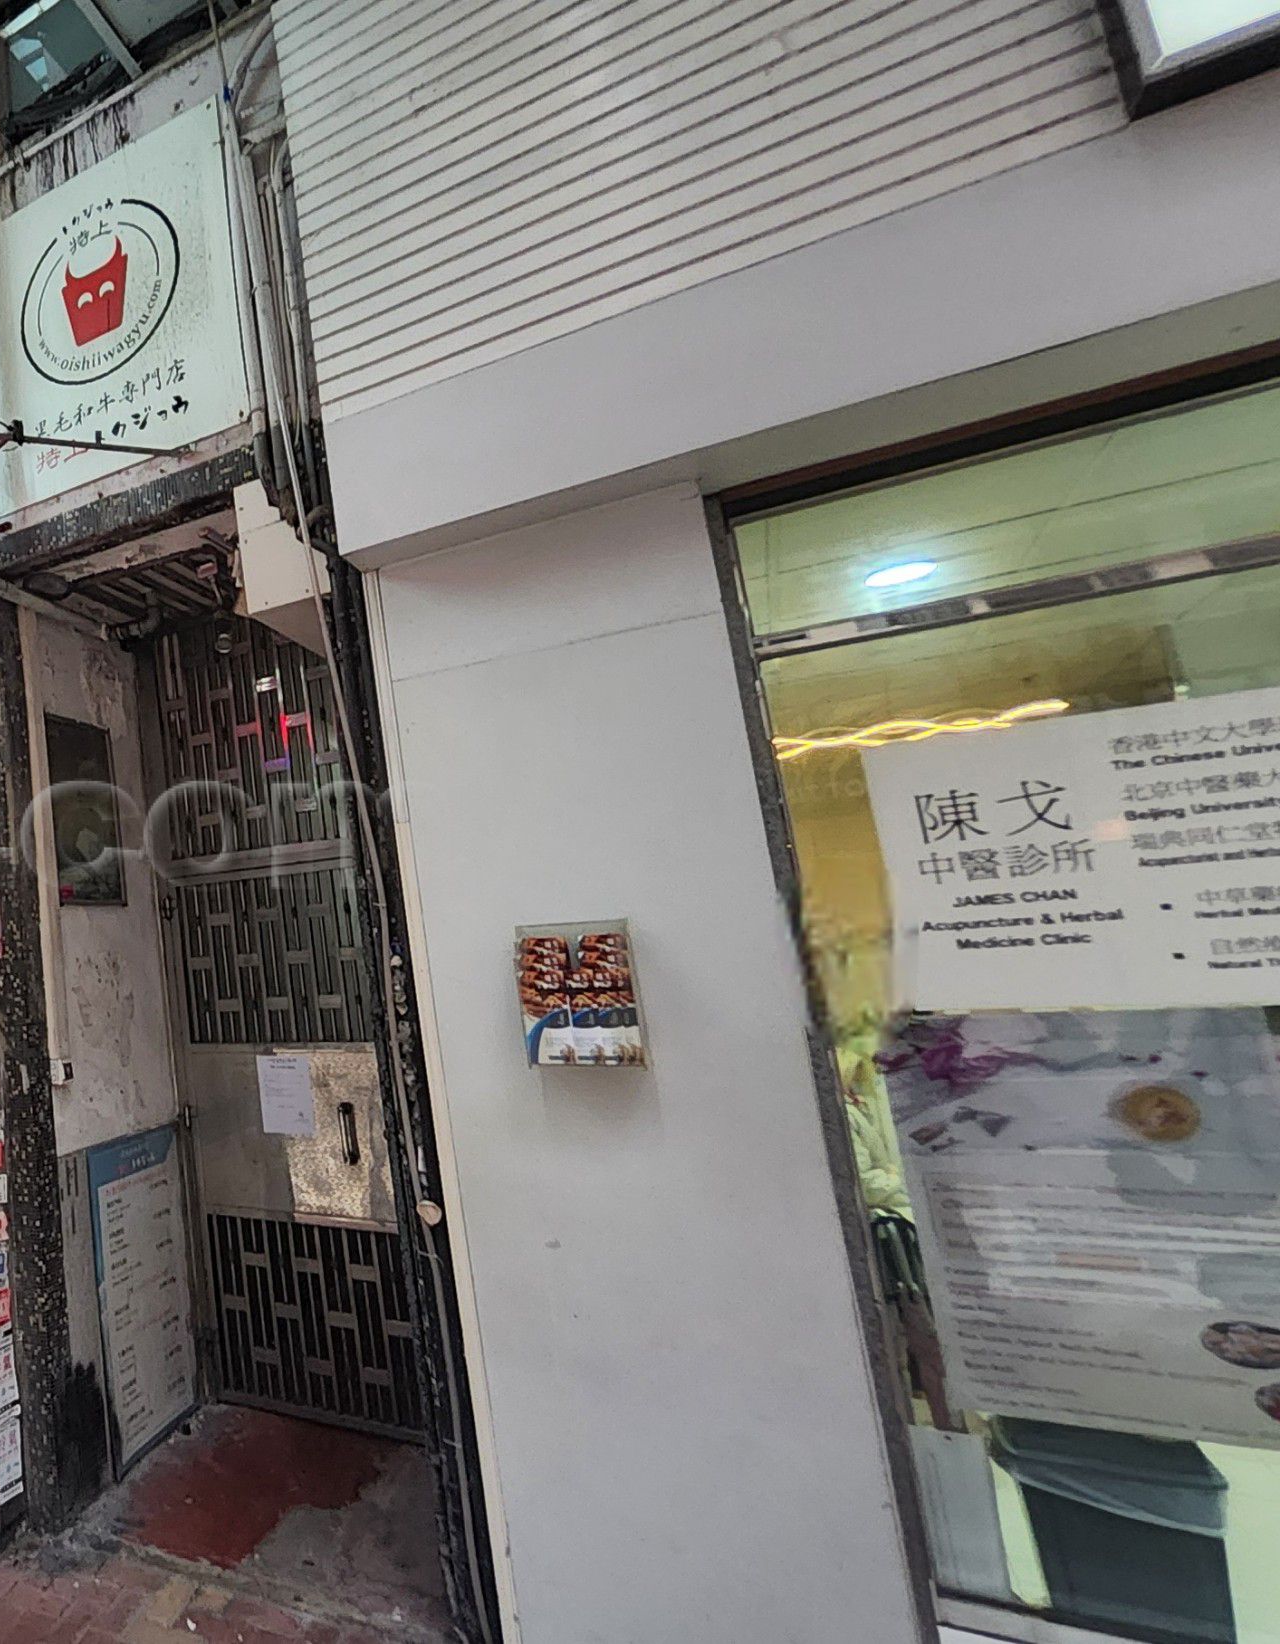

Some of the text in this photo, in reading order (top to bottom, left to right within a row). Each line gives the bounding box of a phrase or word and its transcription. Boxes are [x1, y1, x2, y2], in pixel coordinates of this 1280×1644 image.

[39, 279, 162, 372] www.oishiiwagyu.com
[1110, 759, 1146, 770] The
[1151, 750, 1225, 766] Chinese
[1124, 807, 1185, 822] Beijing
[918, 838, 1095, 885] 中醫診所
[953, 889, 1077, 907] JAMES CHAN
[922, 908, 1124, 931] Acupuncture & Herbal
[957, 933, 1092, 949] Medicine Clinic
